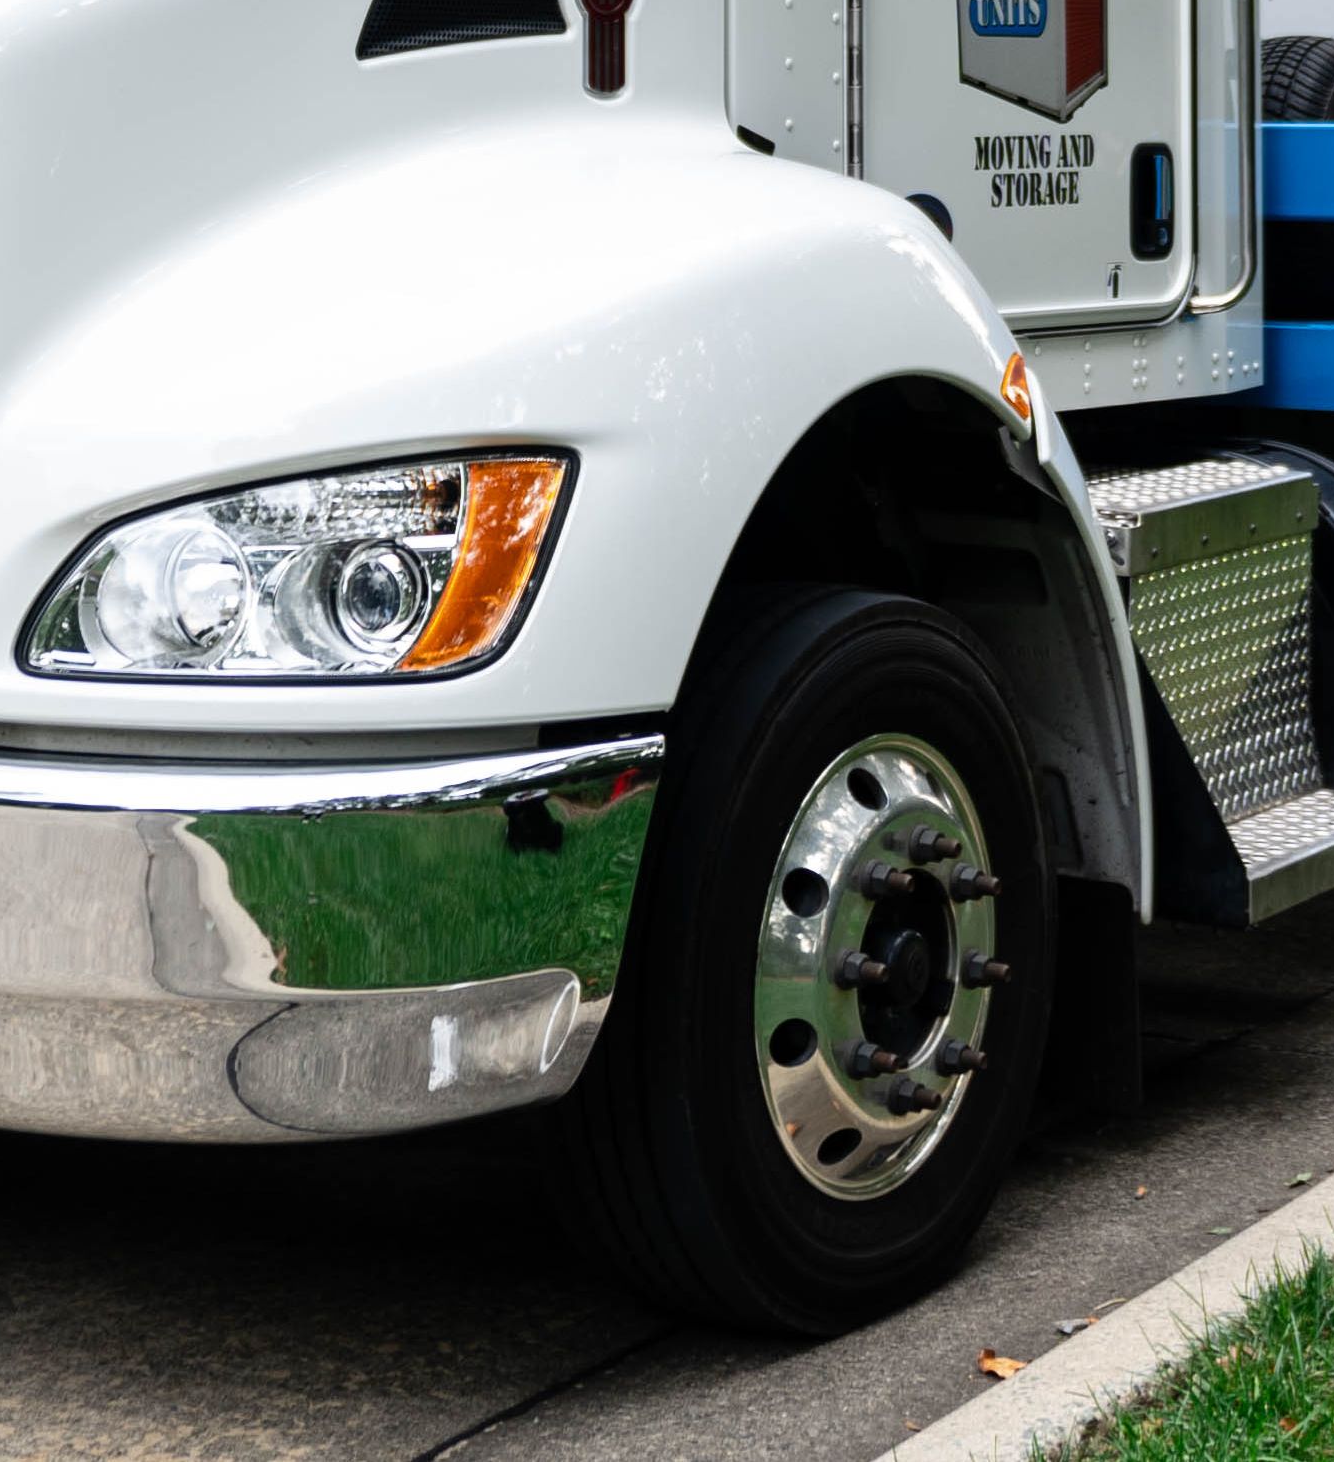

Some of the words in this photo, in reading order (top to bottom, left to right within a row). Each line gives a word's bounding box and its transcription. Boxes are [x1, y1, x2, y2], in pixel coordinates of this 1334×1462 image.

[974, 135, 1052, 171] MOVING
[1056, 134, 1095, 169] AND
[990, 171, 1080, 208] STORAGE
